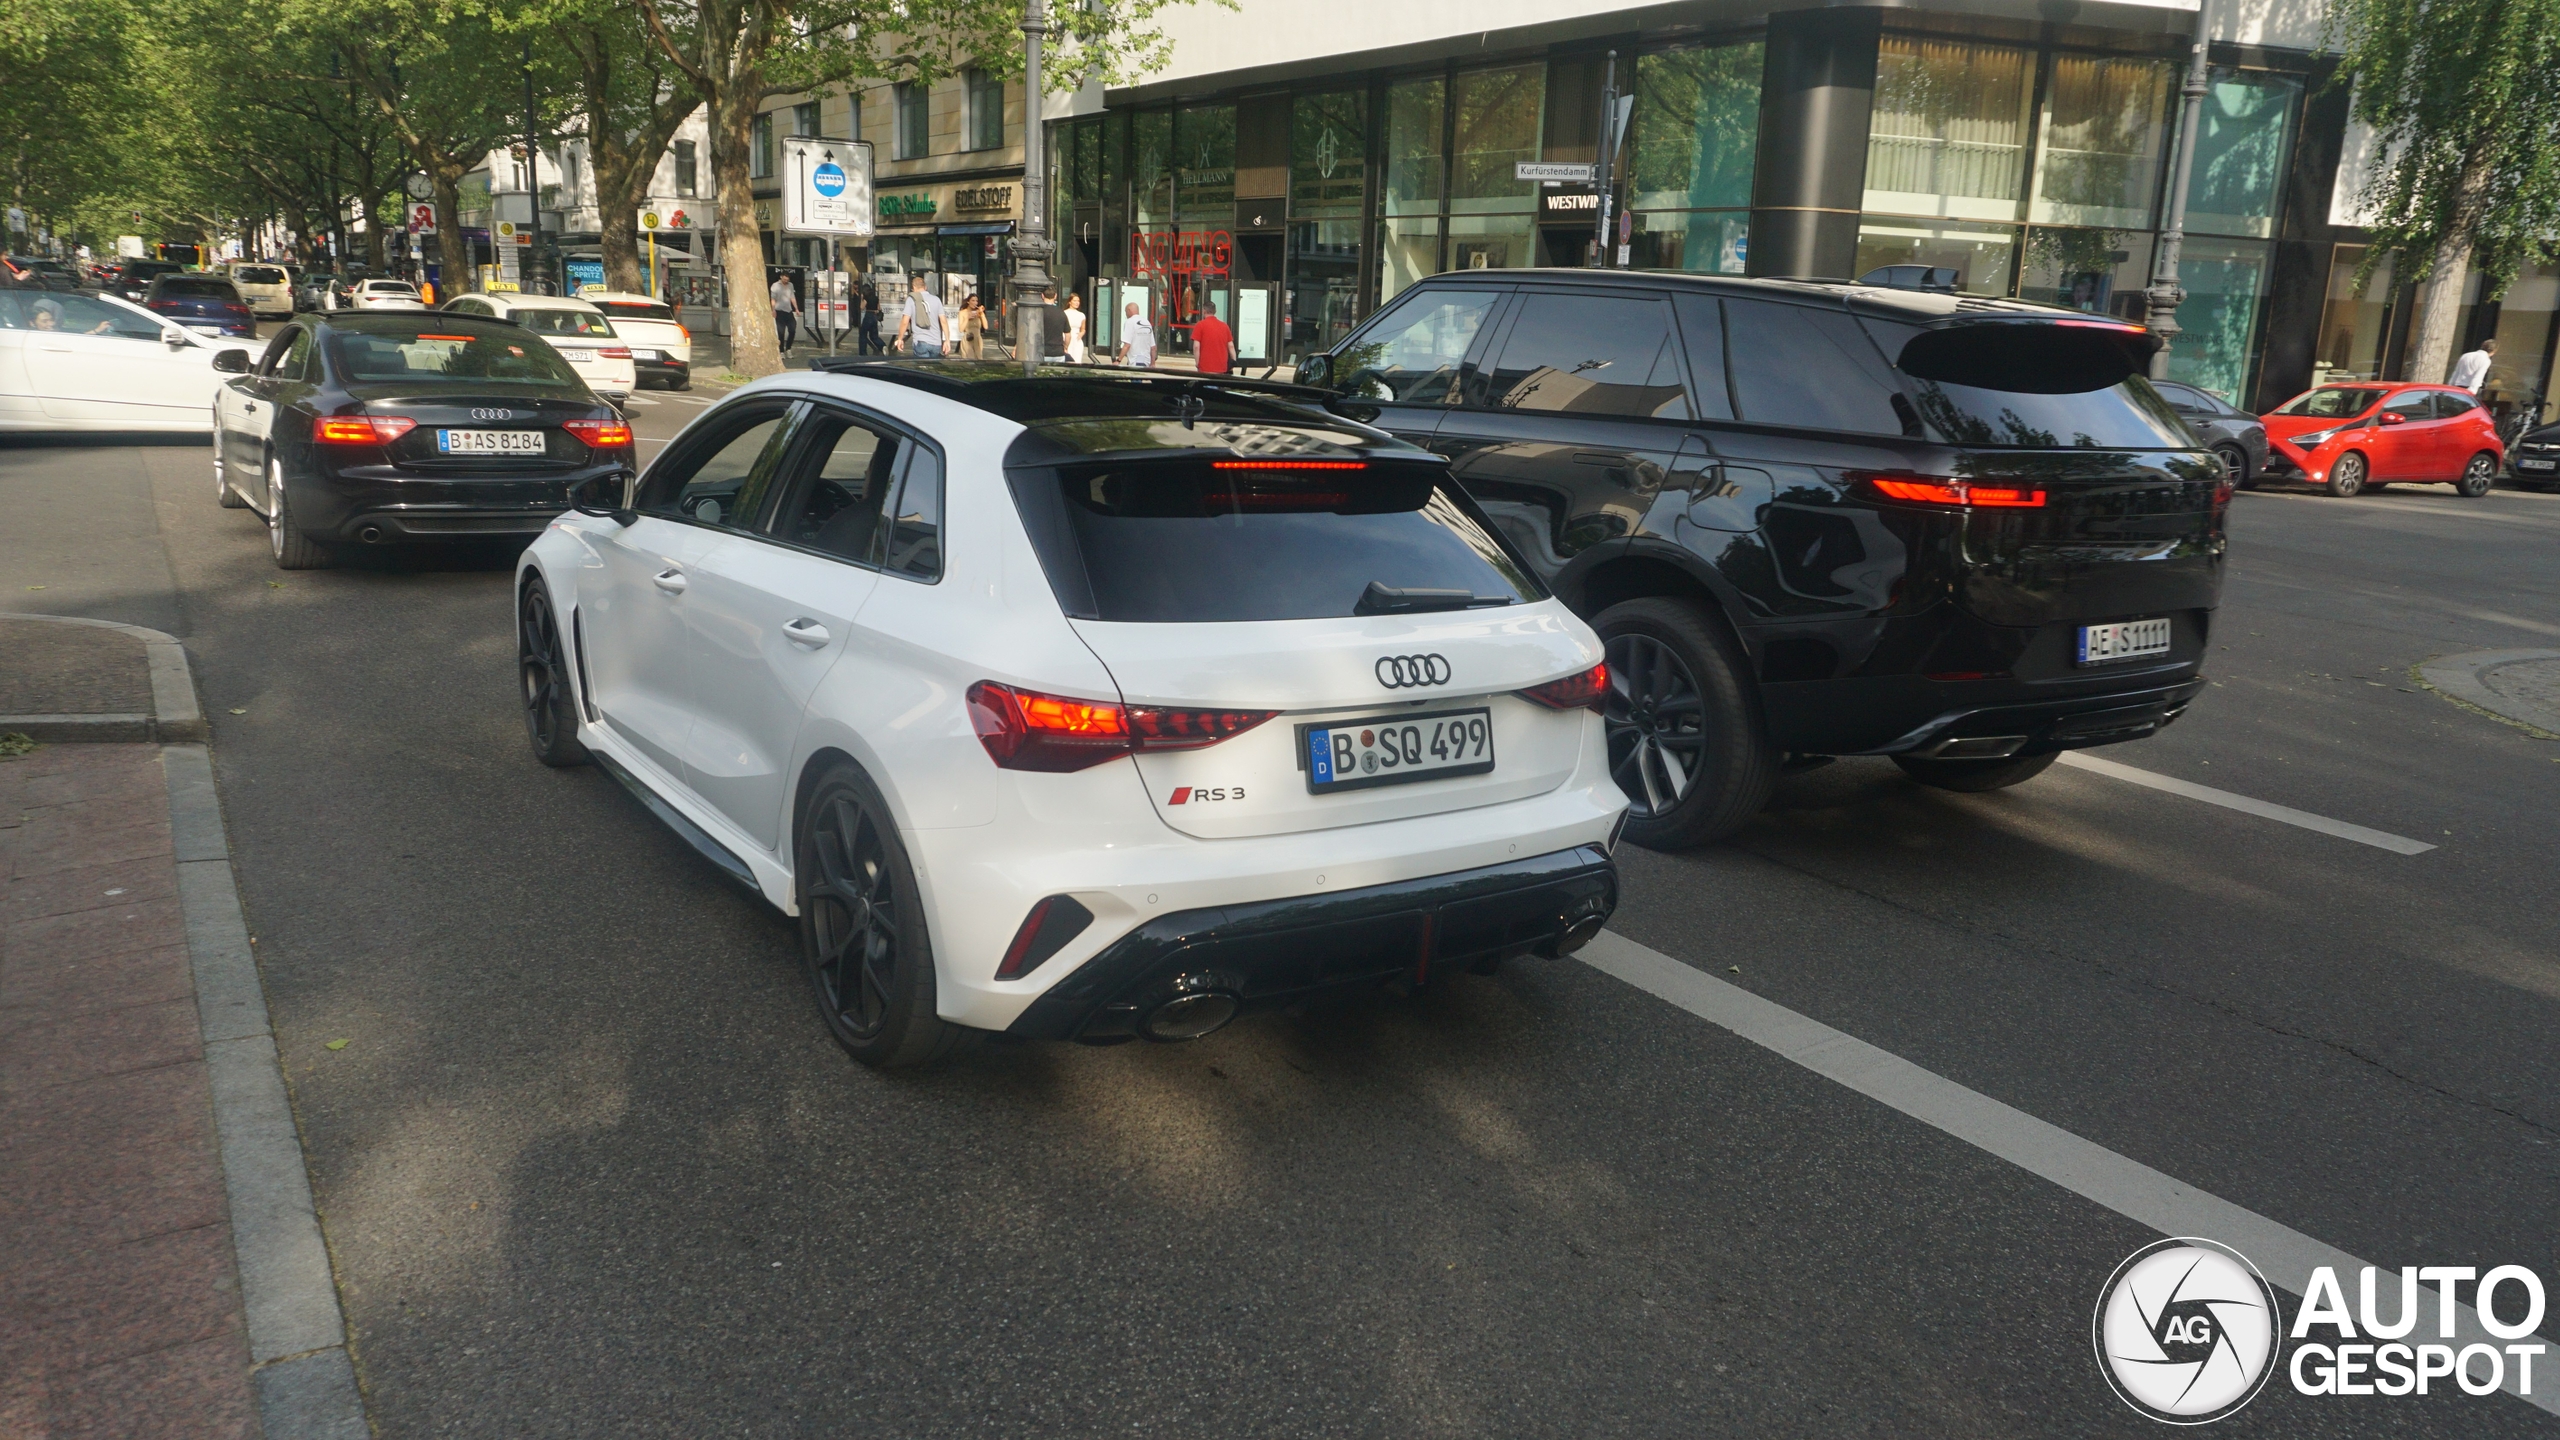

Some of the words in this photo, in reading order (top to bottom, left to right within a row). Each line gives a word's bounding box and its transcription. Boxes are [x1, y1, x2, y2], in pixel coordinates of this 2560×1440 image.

[1182, 171, 1227, 185] HELLMANN
[1520, 165, 1588, 176] Kurfürstendamm
[955, 187, 1012, 208] EDELSTOFF
[1547, 194, 1613, 210] WESTWIN
[1131, 230, 1231, 272] MOVING
[573, 271, 601, 279] SPRITZ
[575, 351, 589, 360] 571
[450, 433, 461, 448] B
[475, 433, 496, 449] AS
[501, 433, 542, 449] 8184
[2089, 629, 2109, 656] AE
[2120, 627, 2130, 652] S
[2133, 623, 2167, 650] 1111
[1318, 762, 1327, 774] D
[1332, 733, 1356, 774] B
[1379, 726, 1423, 768] SQ
[1430, 718, 1487, 761] 499
[1194, 788, 1226, 802] RS
[1232, 787, 1246, 800] 3
